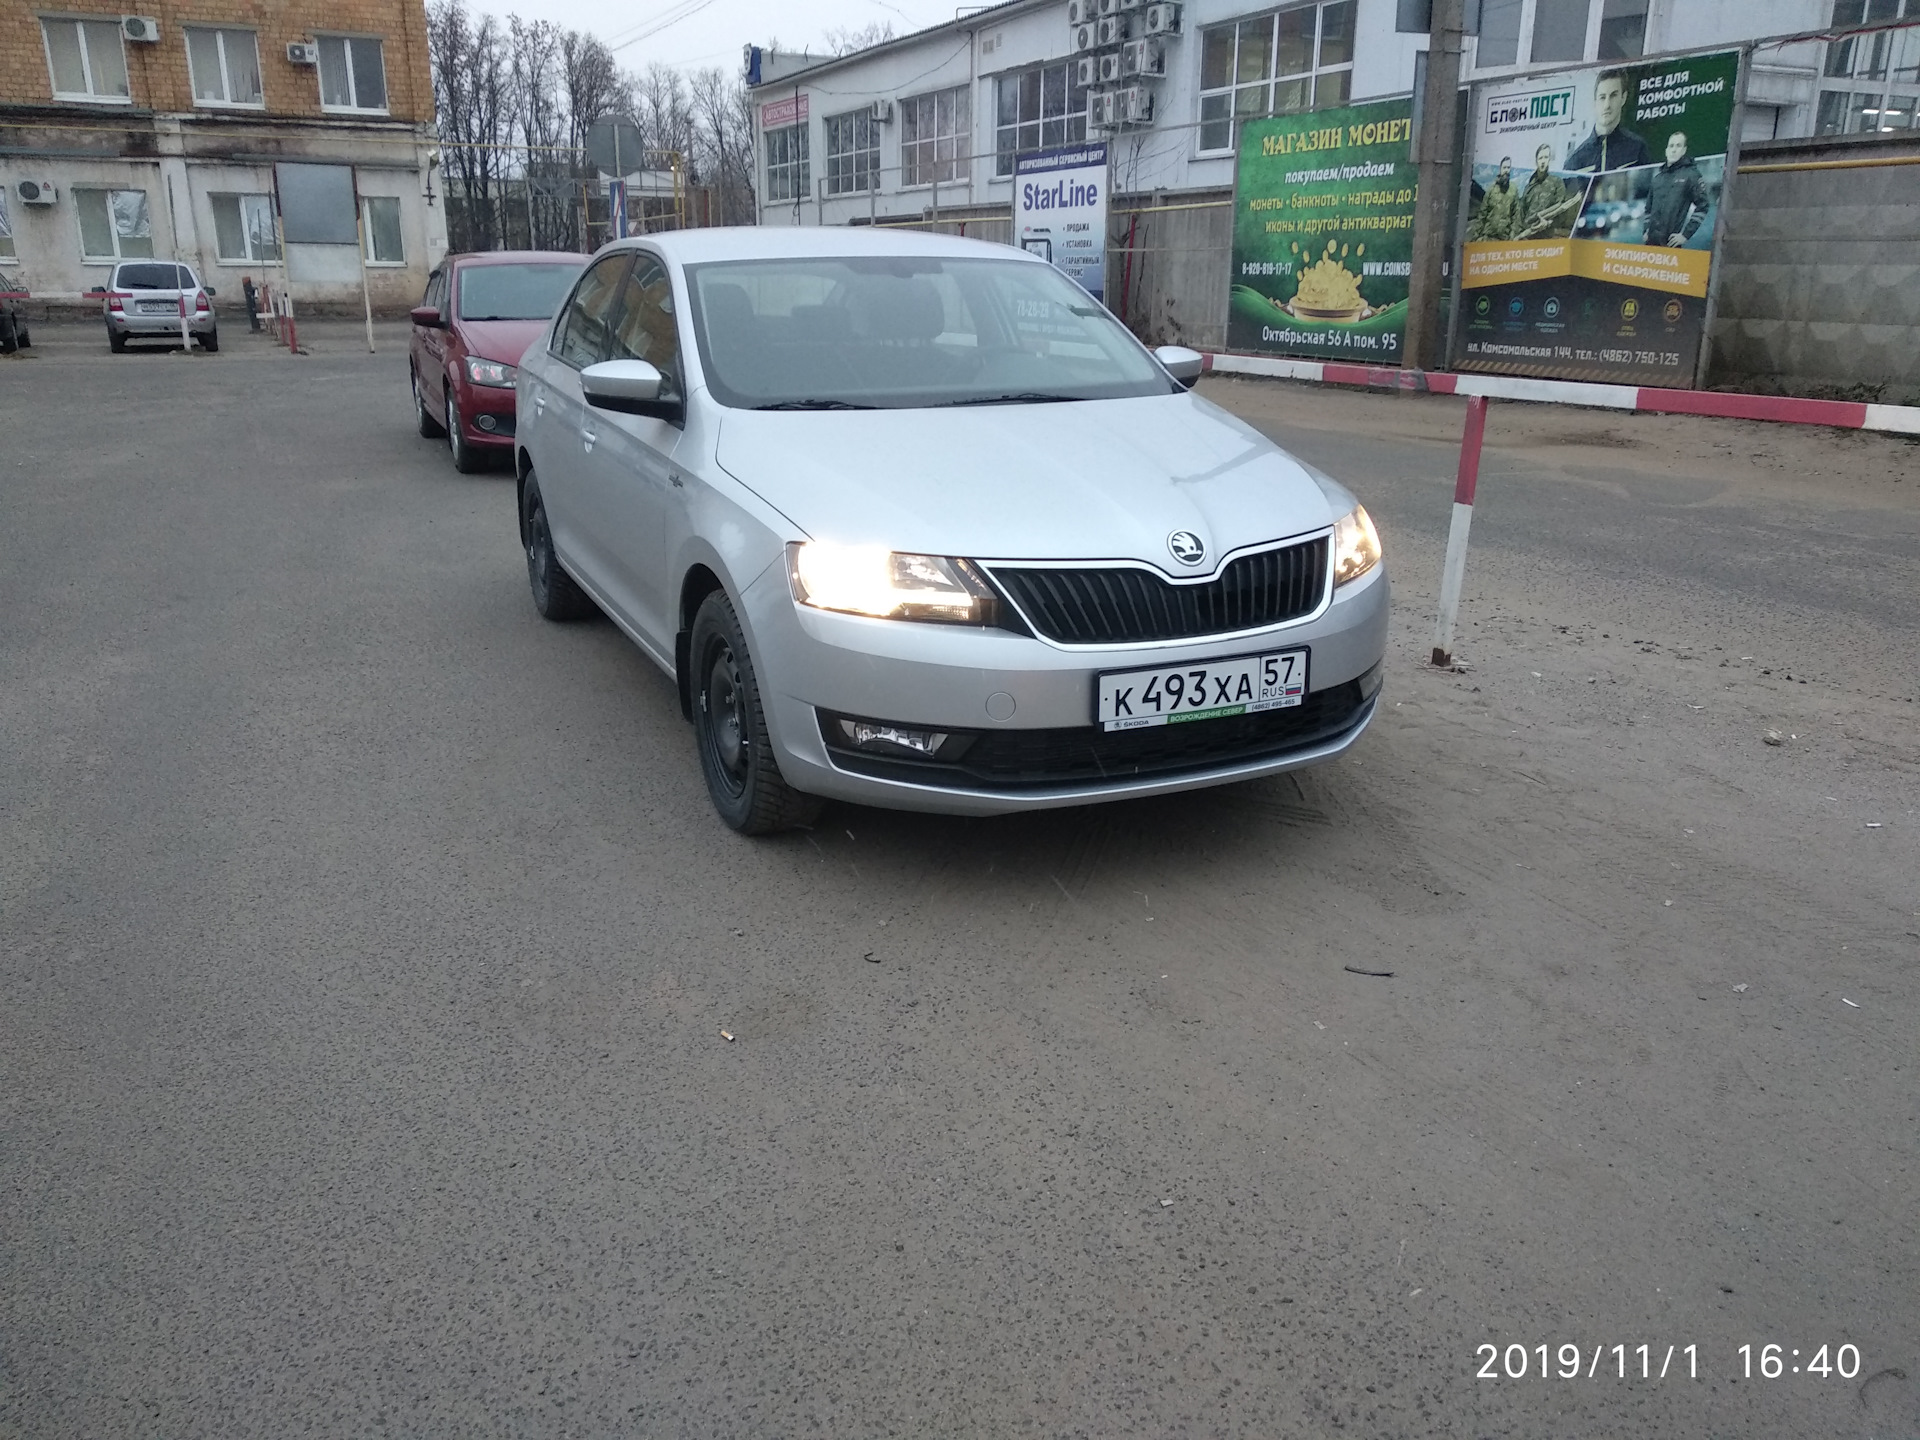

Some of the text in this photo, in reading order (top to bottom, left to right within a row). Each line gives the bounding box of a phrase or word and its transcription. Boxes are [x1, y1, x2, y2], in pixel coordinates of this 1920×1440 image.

[1640, 71, 1690, 90] ВСЕ ДЛЯ
[1638, 78, 1724, 105] КОМФОРТНОЙ
[1636, 102, 1686, 121] РАБОТЫ
[1262, 118, 1412, 156] МАГАЗИН МОНЕТ
[1285, 160, 1395, 185] покупаем/продаем
[1023, 178, 1098, 211] StarLine
[1250, 196, 1284, 211] монеты
[1291, 192, 1339, 208] банкноты
[1348, 188, 1395, 208] награды
[1396, 188, 1412, 204] до
[1066, 223, 1090, 233] ПРОДАЖА
[1265, 213, 1413, 235] иконы и другой антиквариат
[1066, 240, 1092, 249] УСТАНОВКА
[1066, 255, 1100, 265] ГАРАНТИЙНЫЙ
[1469, 246, 1565, 264] ДЛЯ ТЕХ, КТО НЕ СИДИТ
[1604, 247, 1679, 268] ЭКИПИРОВКА
[1066, 268, 1084, 277] СЕРВИС
[1469, 260, 1539, 275] НА ОДНОМ МЕСТЕ
[1602, 263, 1690, 285] И СНАРЯЖЕНИЕ
[1262, 326, 1397, 350] Октябрьская 56 А пом. 95
[1554, 346, 1573, 359] 144,
[1599, 349, 1633, 364] (4862)
[1634, 351, 1680, 366] 750-125
[1264, 656, 1295, 686] 57
[1262, 685, 1285, 699] RUS
[1251, 698, 1296, 711] (4862) 495-465
[1170, 706, 1244, 723] ВОЗРОЖДЕНИЕ СЕВЕР
